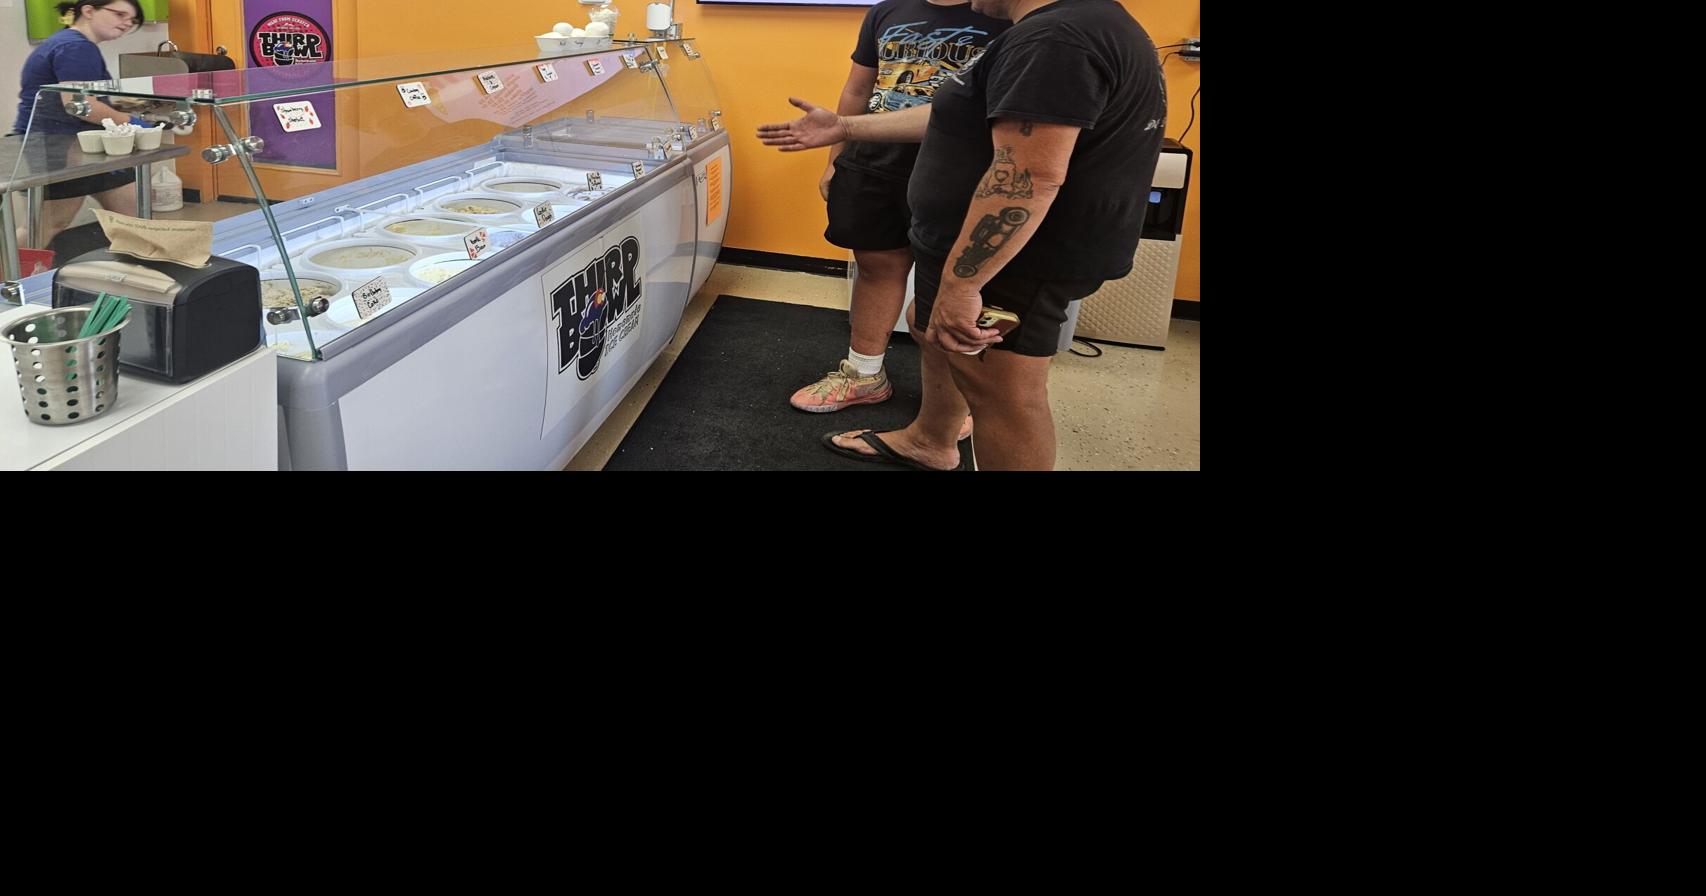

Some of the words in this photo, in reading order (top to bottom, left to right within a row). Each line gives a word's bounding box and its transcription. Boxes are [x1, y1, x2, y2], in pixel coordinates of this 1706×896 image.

[257, 32, 322, 46] THIRD
[550, 235, 641, 322] THIRD
[603, 335, 618, 357] ICE
[619, 315, 640, 341] CREAM
[607, 304, 641, 342] Homemade
